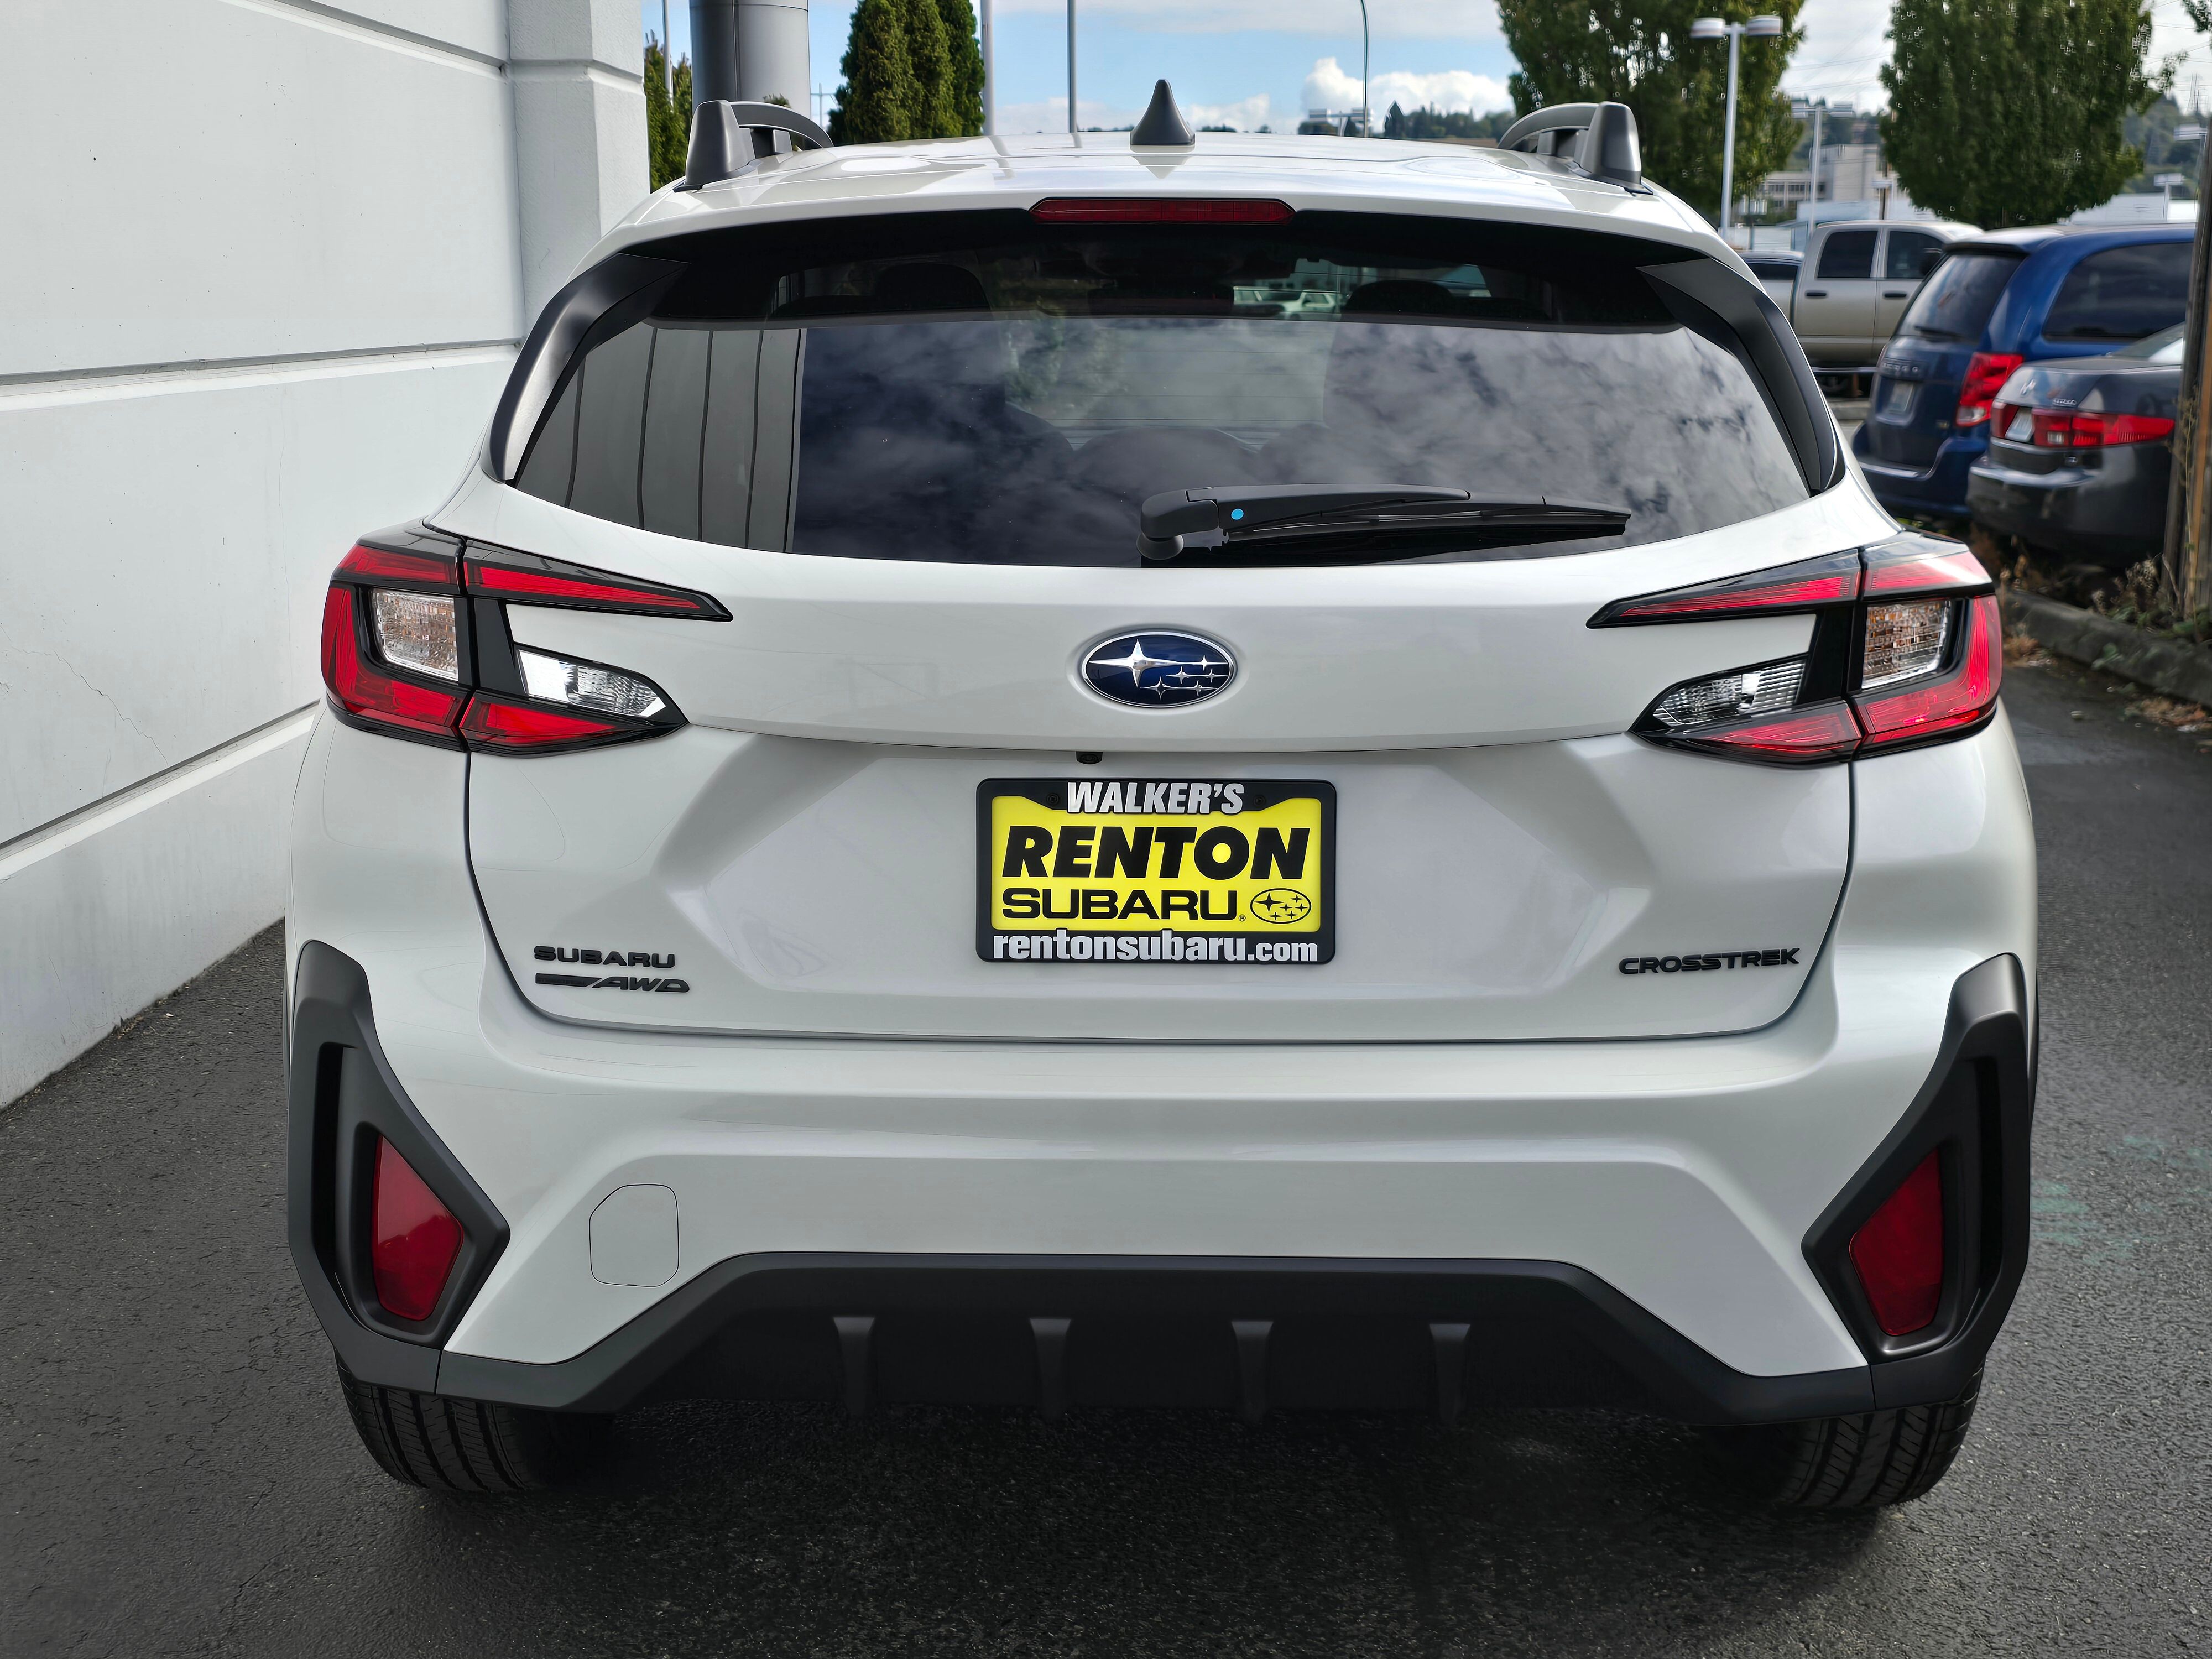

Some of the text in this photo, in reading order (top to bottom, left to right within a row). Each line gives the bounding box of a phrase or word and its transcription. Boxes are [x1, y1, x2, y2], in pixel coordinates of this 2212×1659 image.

[1067, 782, 1244, 814] WALKER'S
[1002, 826, 1310, 880] RENTON
[534, 945, 675, 968] SUBARU
[993, 929, 1318, 962] rentonsubaru.com
[1618, 947, 1800, 974] CROSSTREK
[592, 976, 690, 993] AWD
